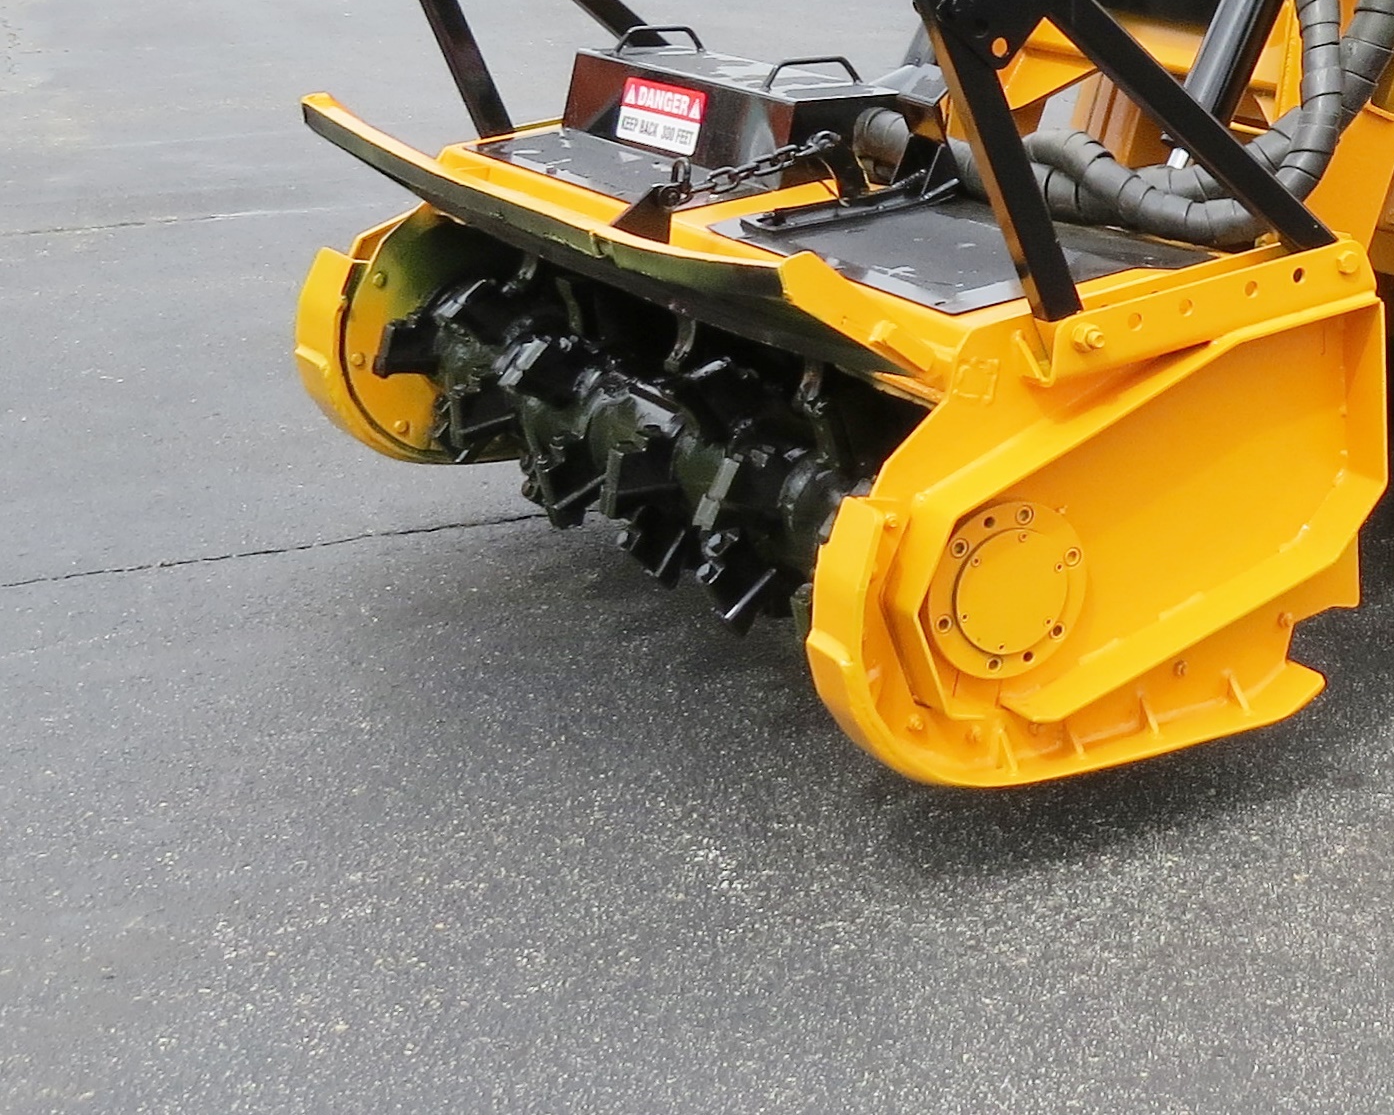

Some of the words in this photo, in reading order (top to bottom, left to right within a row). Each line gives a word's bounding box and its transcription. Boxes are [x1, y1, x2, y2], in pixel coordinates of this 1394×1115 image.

[636, 85, 691, 117] DANGER
[621, 115, 639, 132] KEEP
[639, 119, 659, 138] BACK
[674, 127, 695, 146] FEET
